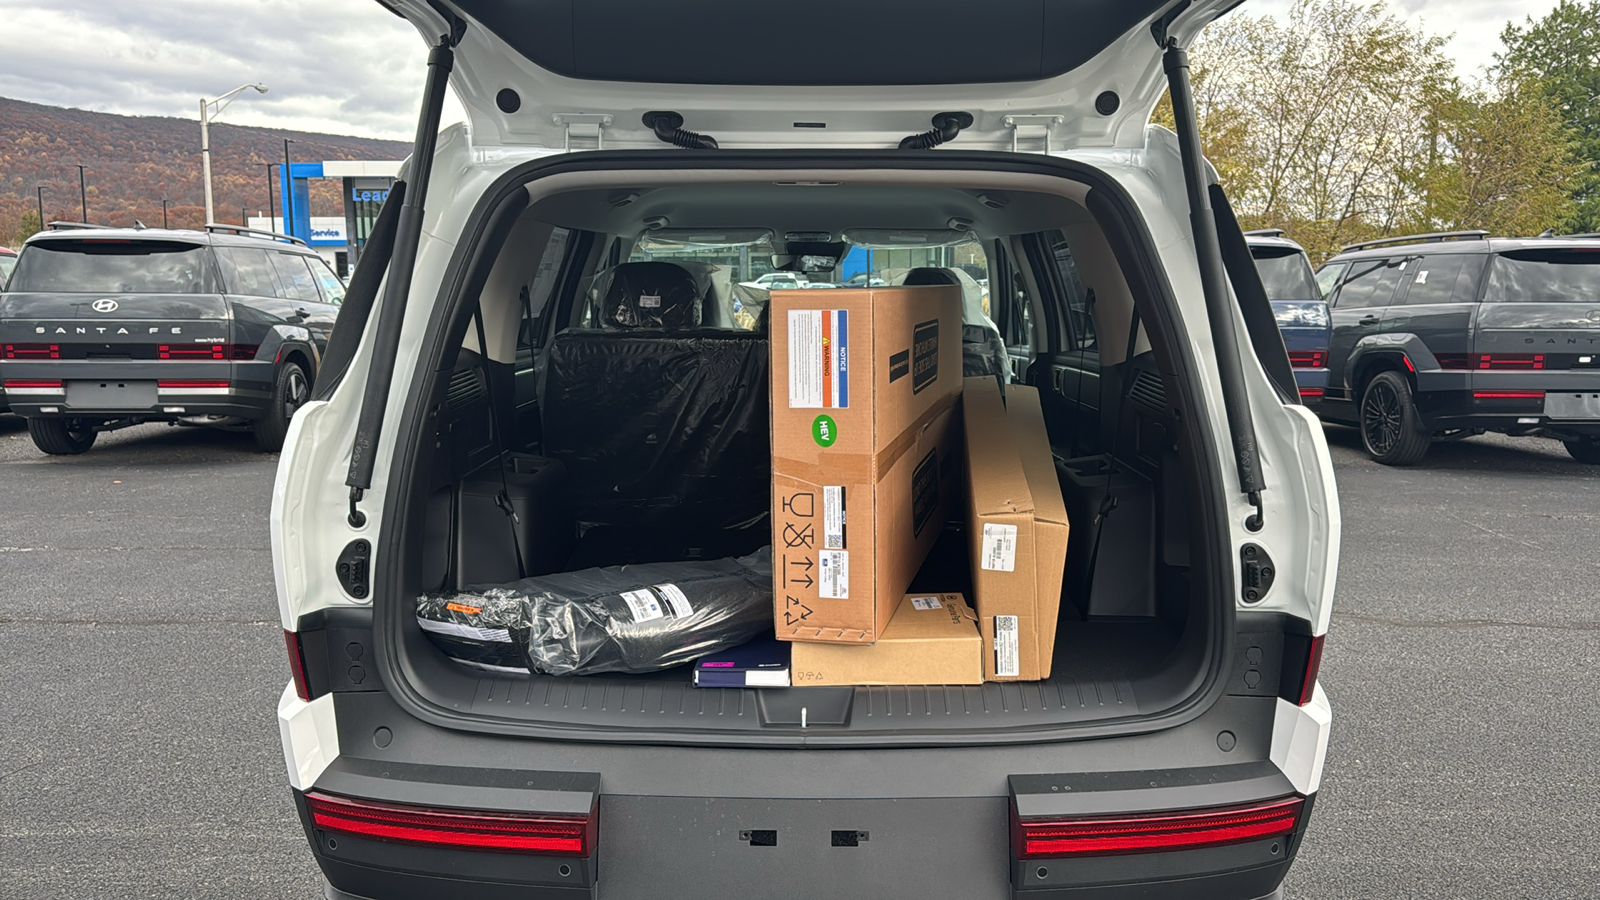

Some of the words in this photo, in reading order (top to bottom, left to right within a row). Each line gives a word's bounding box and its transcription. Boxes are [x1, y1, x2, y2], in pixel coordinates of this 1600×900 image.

[35, 326, 129, 335] SANTA
[148, 326, 182, 335] FE
[819, 420, 830, 441] HEV
